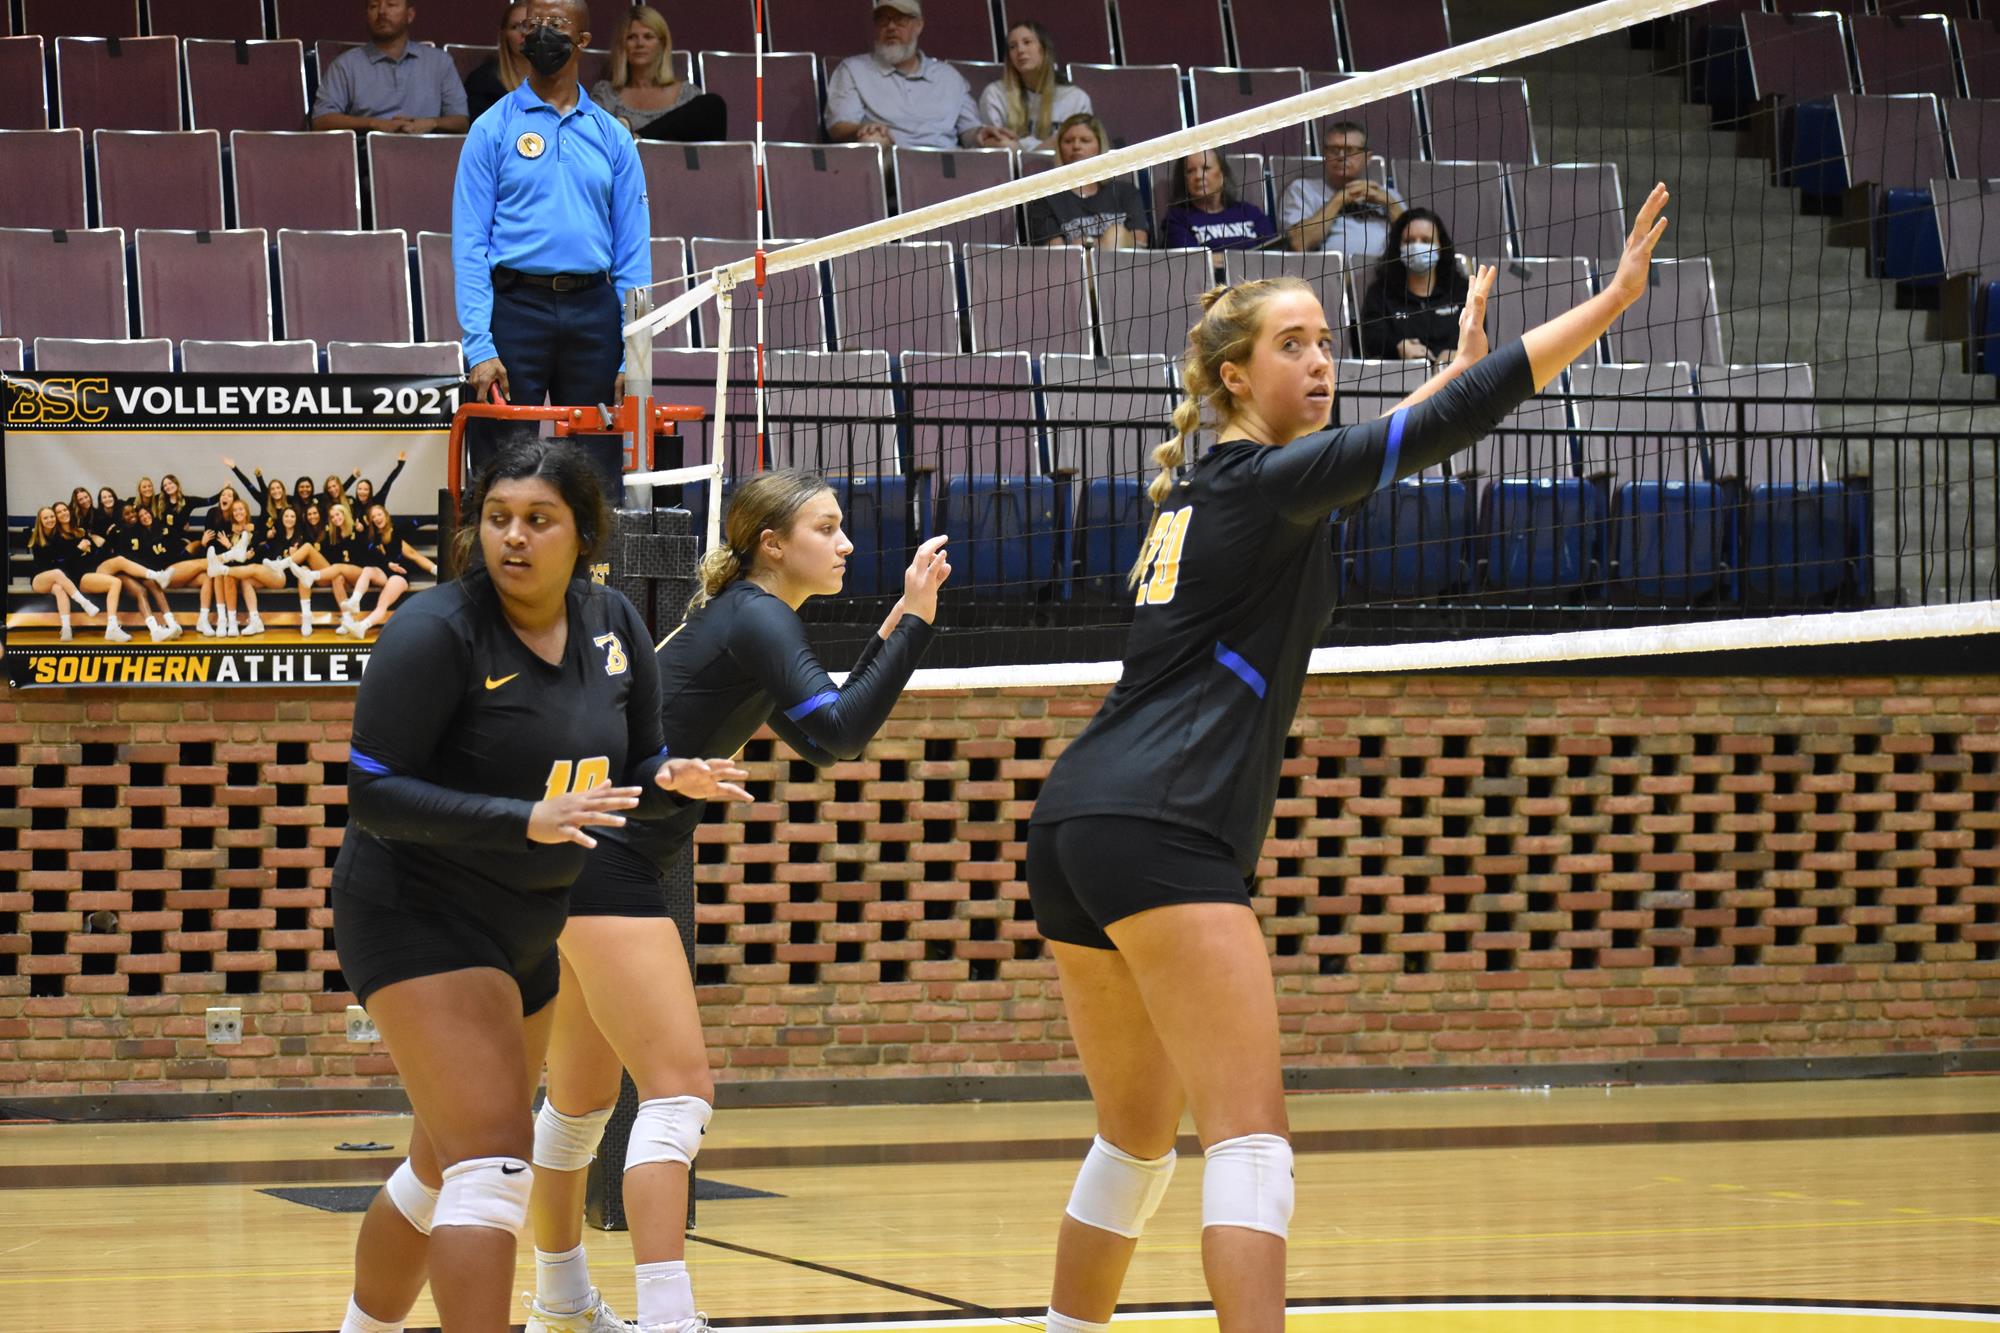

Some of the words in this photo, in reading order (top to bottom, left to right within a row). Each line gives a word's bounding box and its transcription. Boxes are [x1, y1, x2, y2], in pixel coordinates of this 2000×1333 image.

[7, 378, 109, 423] BSC
[114, 386, 363, 415] VOLLEYBALL
[372, 386, 460, 415] 2021
[28, 656, 211, 684] 'SOUTHERN
